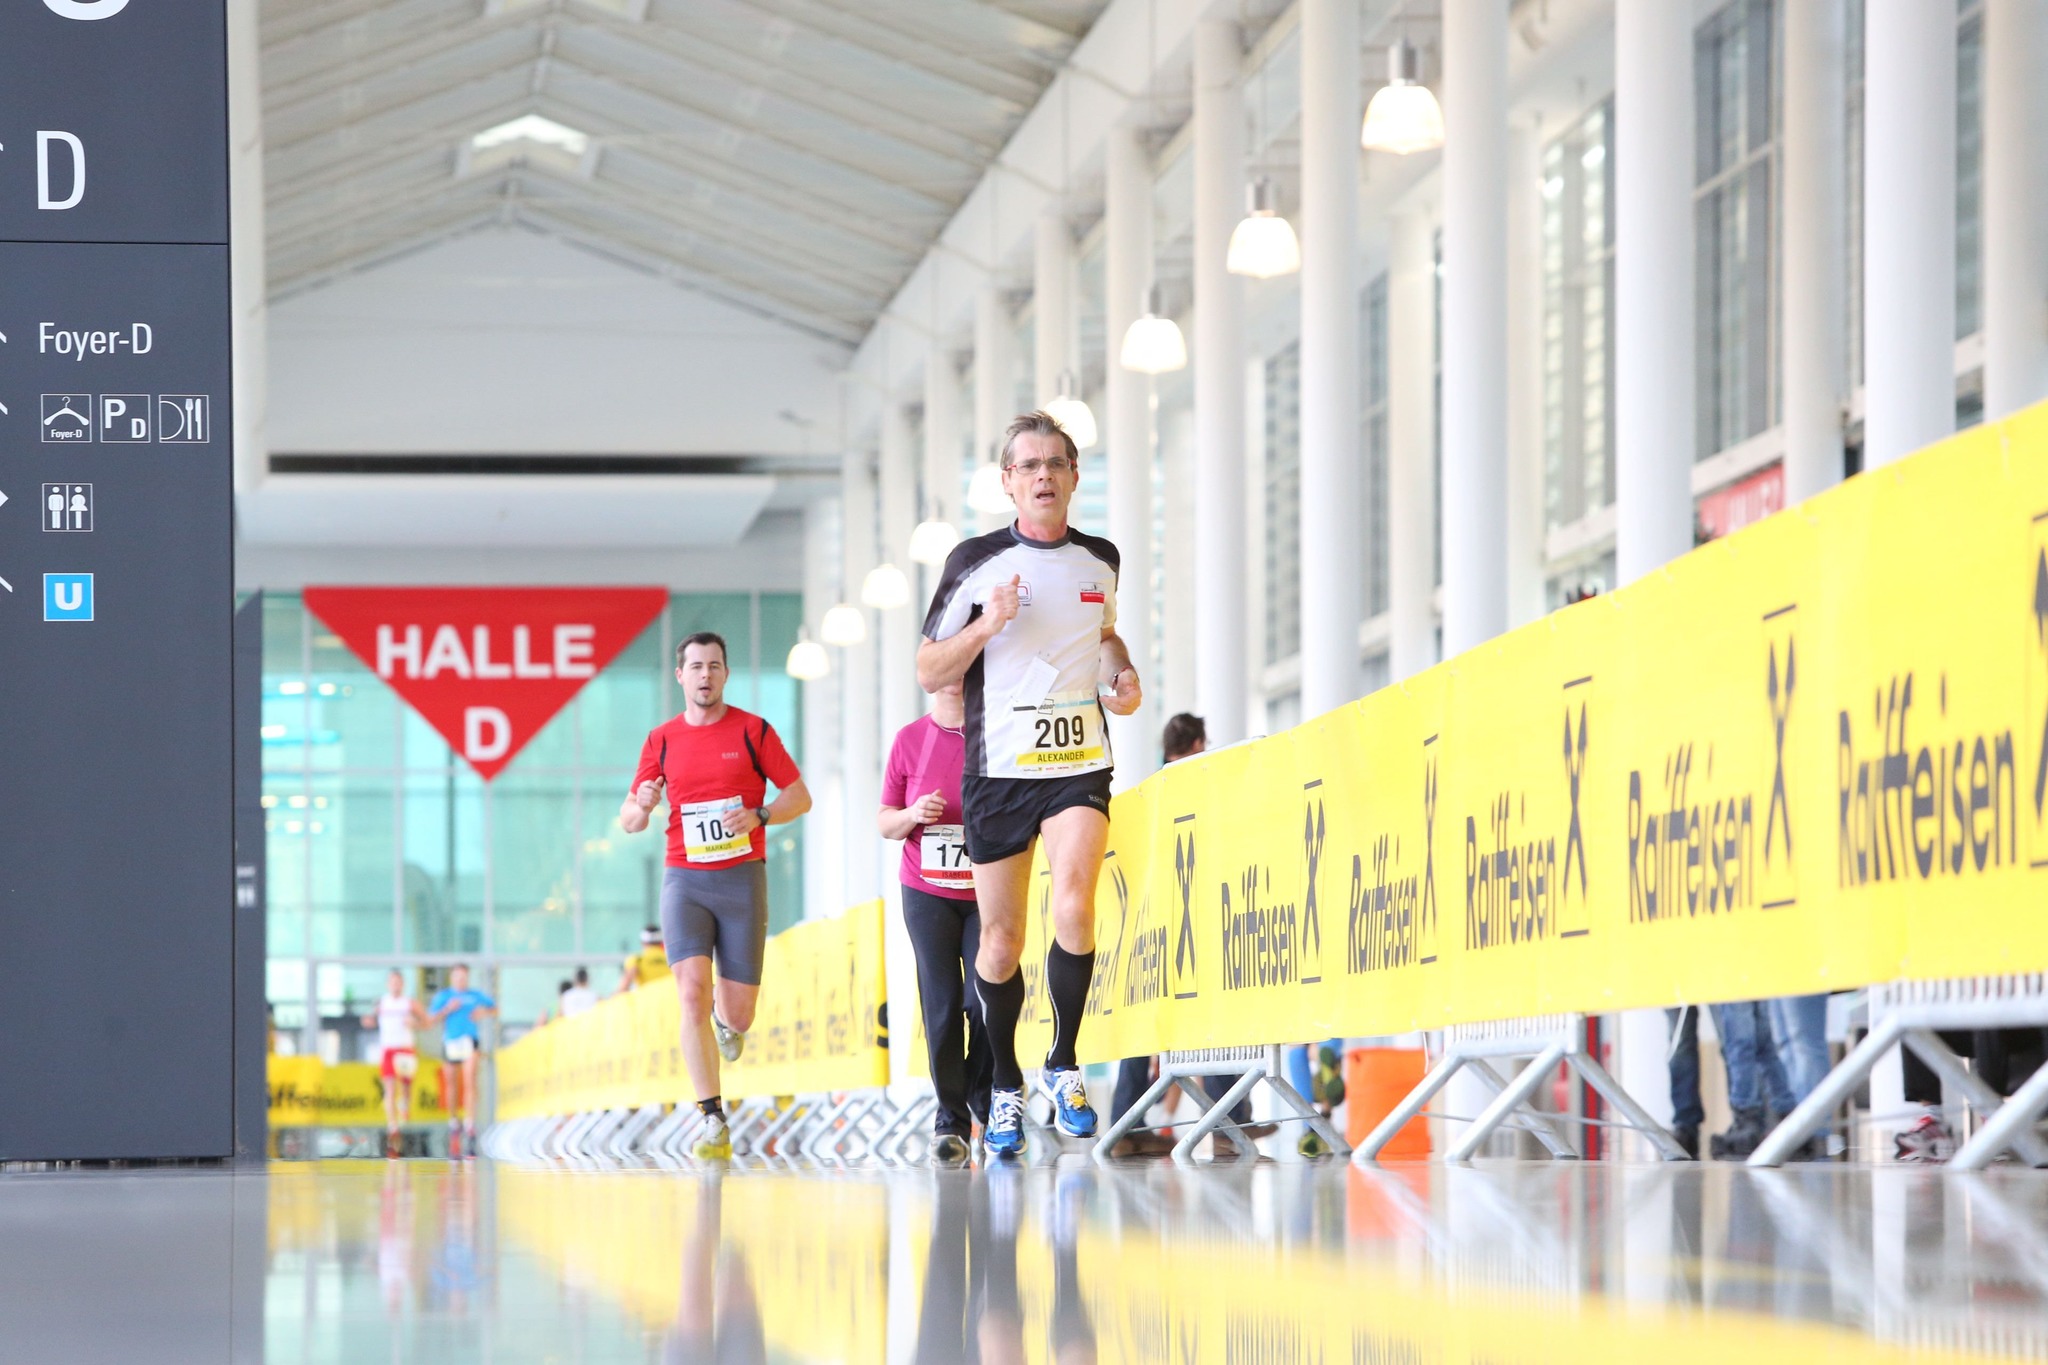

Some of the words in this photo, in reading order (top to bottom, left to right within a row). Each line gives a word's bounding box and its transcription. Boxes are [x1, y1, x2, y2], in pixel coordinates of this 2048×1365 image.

[36, 130, 86, 210] D
[39, 322, 152, 361] Foyer-D
[50, 429, 83, 439] Foyer-D
[104, 399, 126, 428] P
[131, 418, 146, 438] D
[54, 582, 83, 611] U
[376, 624, 596, 680] HALLE
[464, 707, 512, 762] D
[1035, 715, 1085, 748] 209
[1037, 751, 1085, 763] ALEXANDER
[1839, 671, 2016, 889] Raiffeisen
[696, 819, 735, 842] 10
[705, 842, 732, 852] MARKUS
[1628, 742, 1754, 924] Raiffeisen
[936, 844, 972, 867] 17
[1466, 791, 1556, 951] Raiffeisen
[1348, 833, 1418, 975] Raiffeisen
[1221, 863, 1298, 991] Raiffeisen
